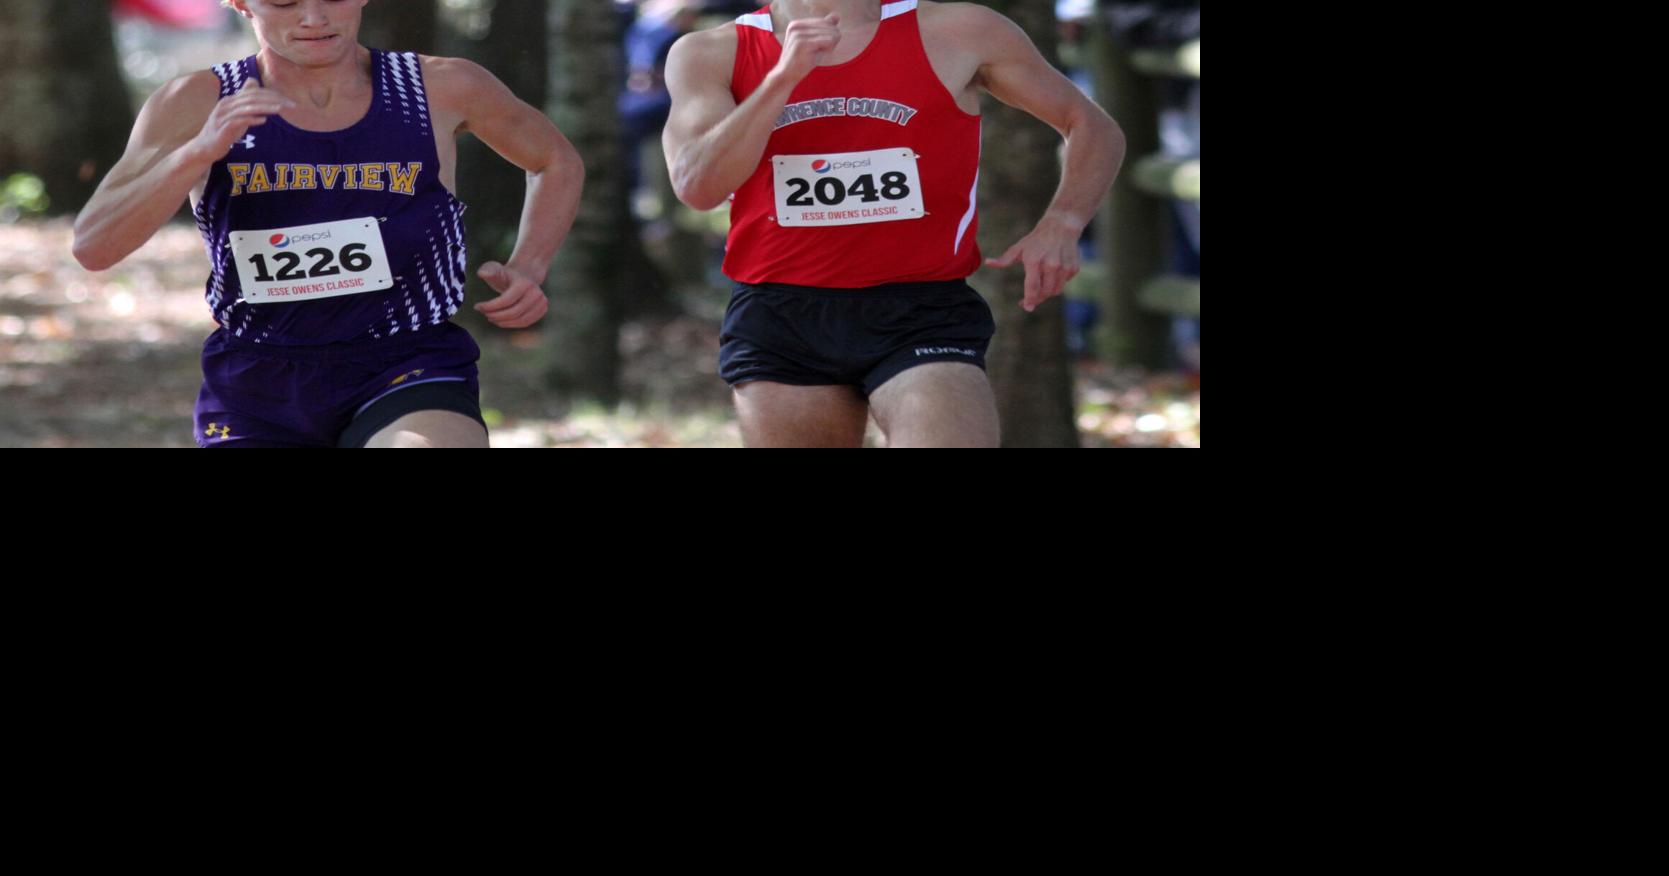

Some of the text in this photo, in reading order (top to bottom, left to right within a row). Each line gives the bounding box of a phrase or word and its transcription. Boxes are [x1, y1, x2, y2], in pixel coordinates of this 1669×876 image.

[847, 97, 918, 127] COUNTY
[832, 158, 871, 170] pepsi
[227, 162, 422, 195] FAIRVIEW
[785, 171, 910, 206] 2048
[801, 206, 898, 221] JESSE OWENS CLASSIC
[291, 230, 332, 244] pepsi
[248, 243, 372, 282] 1226
[267, 278, 365, 297] JESSE OWENS CLASSIC
